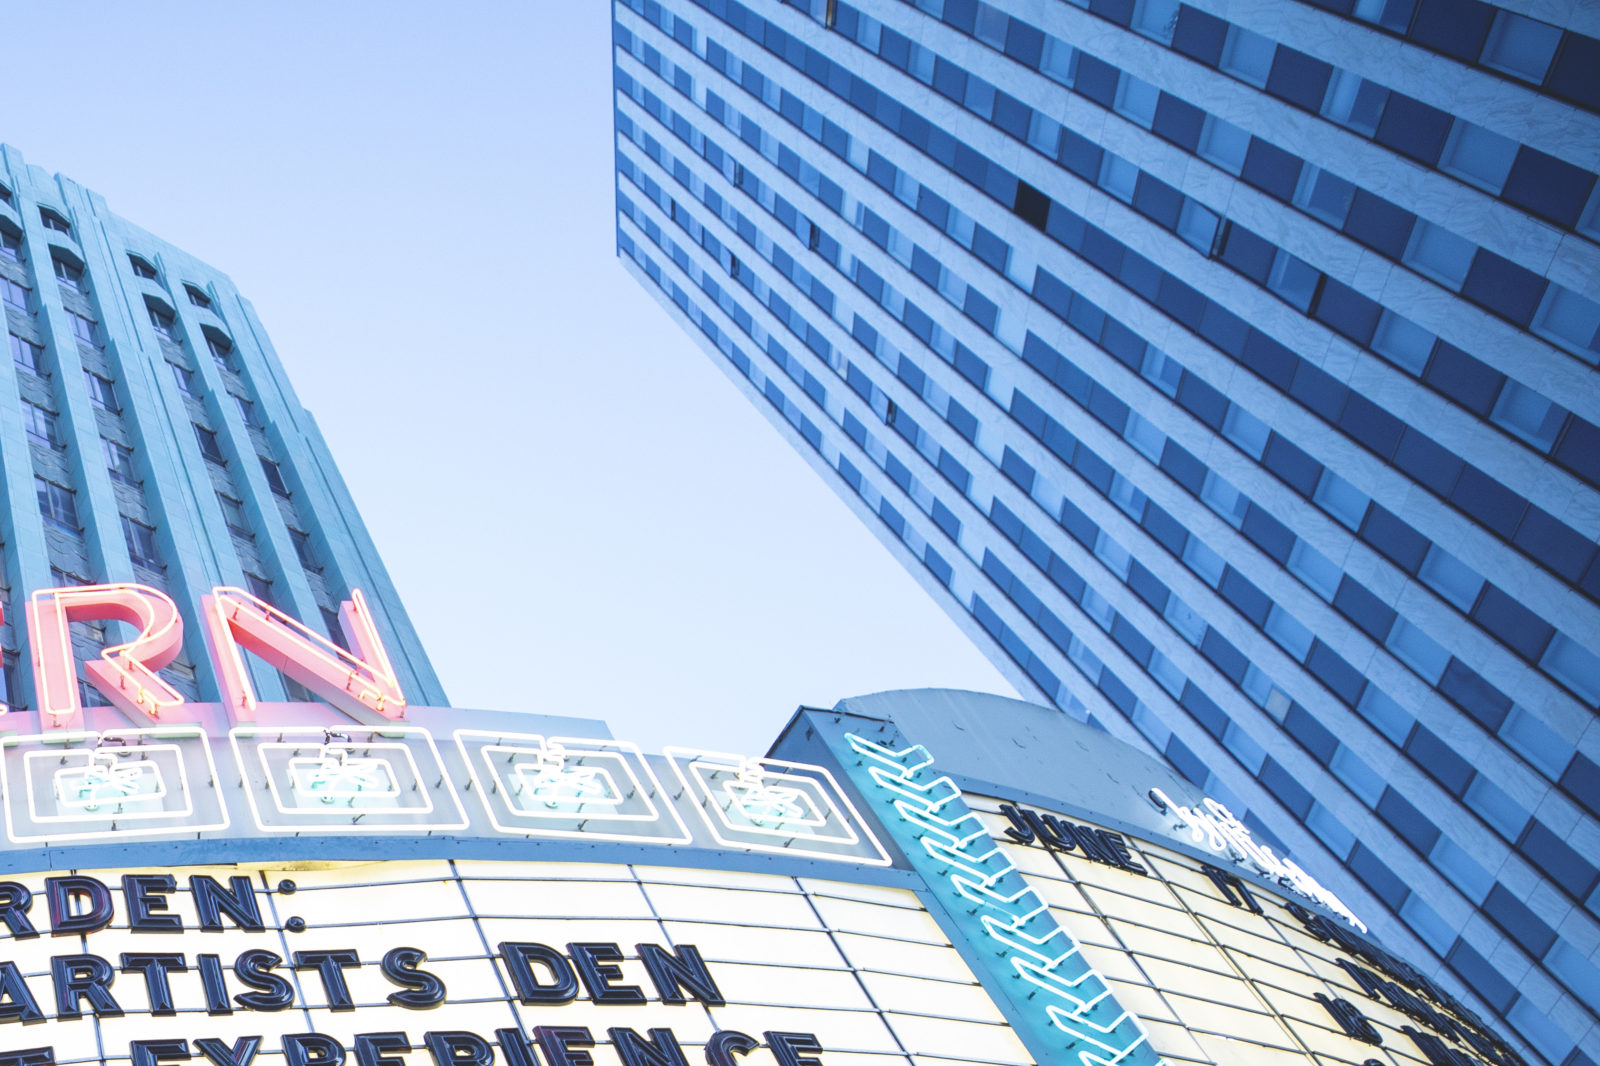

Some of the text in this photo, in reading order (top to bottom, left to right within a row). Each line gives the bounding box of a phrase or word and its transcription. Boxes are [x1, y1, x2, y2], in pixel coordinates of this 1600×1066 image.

[997, 802, 1149, 877] JUNE
[1200, 864, 1264, 916] 17
[497, 940, 726, 1007] DEN
